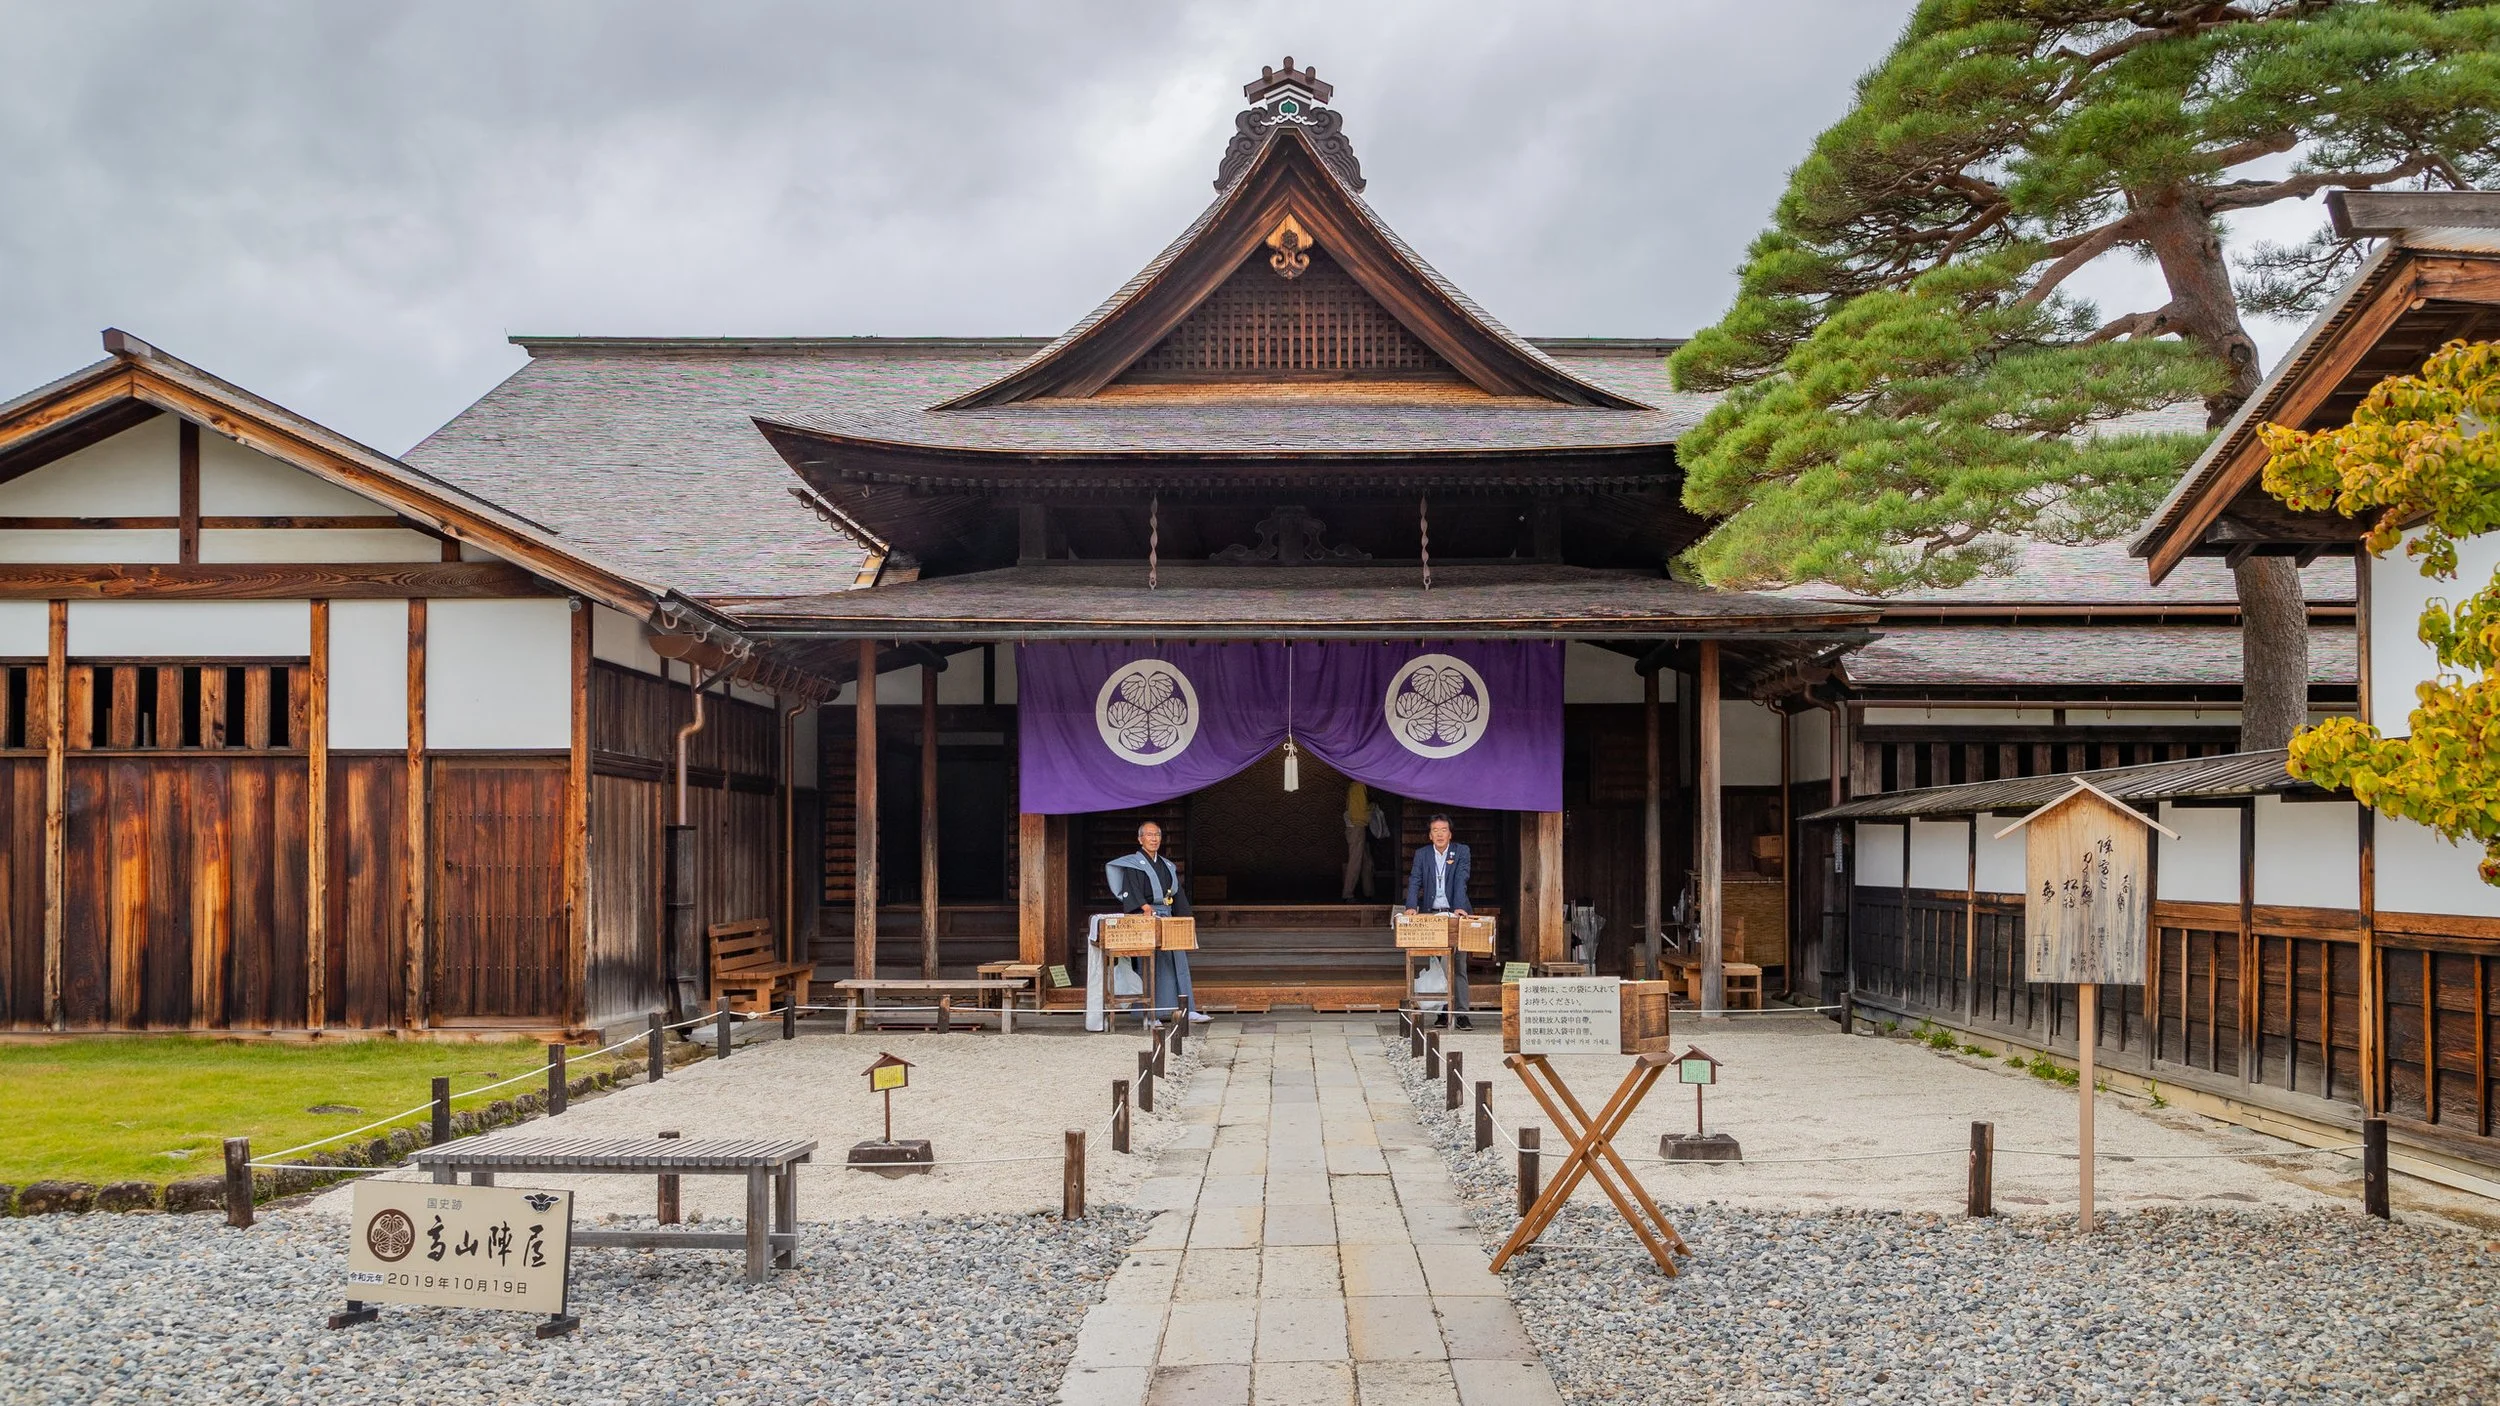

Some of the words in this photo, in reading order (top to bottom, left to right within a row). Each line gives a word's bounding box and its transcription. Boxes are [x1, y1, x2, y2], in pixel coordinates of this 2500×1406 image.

[1525, 985, 1615, 994] お履物は、この袋に入れて
[1525, 998, 1582, 1006] お持ちください。
[427, 1198, 463, 1210] 国史跡
[427, 1215, 546, 1267] 高山陣屋
[350, 1271, 384, 1282] 令和元年
[388, 1272, 527, 1294] 2019年10月19日
